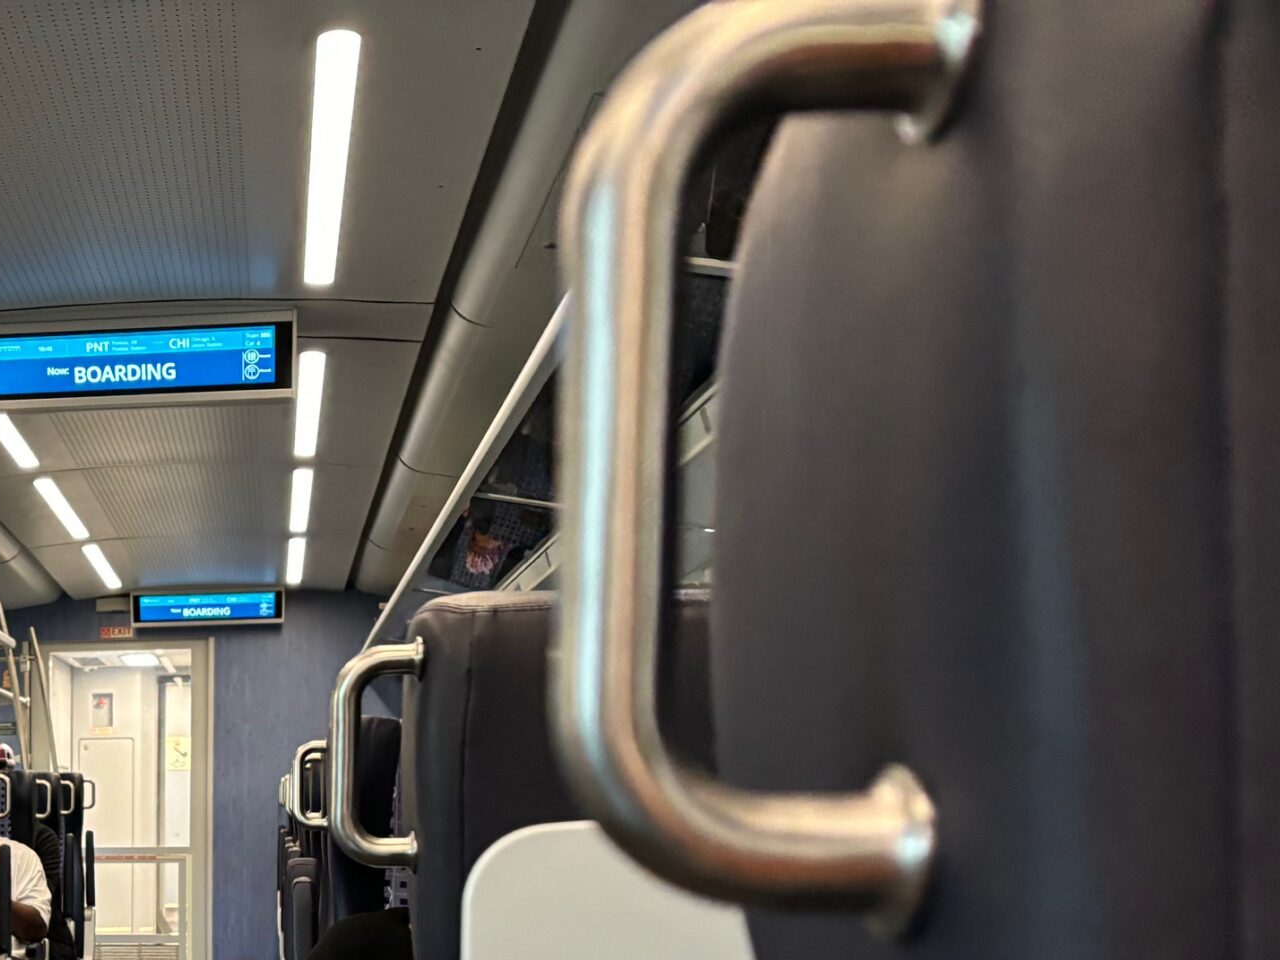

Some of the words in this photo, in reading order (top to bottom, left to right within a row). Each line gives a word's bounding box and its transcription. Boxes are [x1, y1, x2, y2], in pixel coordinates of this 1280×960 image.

[85, 340, 111, 353] PNT
[168, 337, 191, 350] CHI
[74, 362, 177, 384] BOARDING
[182, 606, 231, 618] BOARDING
[111, 627, 132, 637] EXIT
